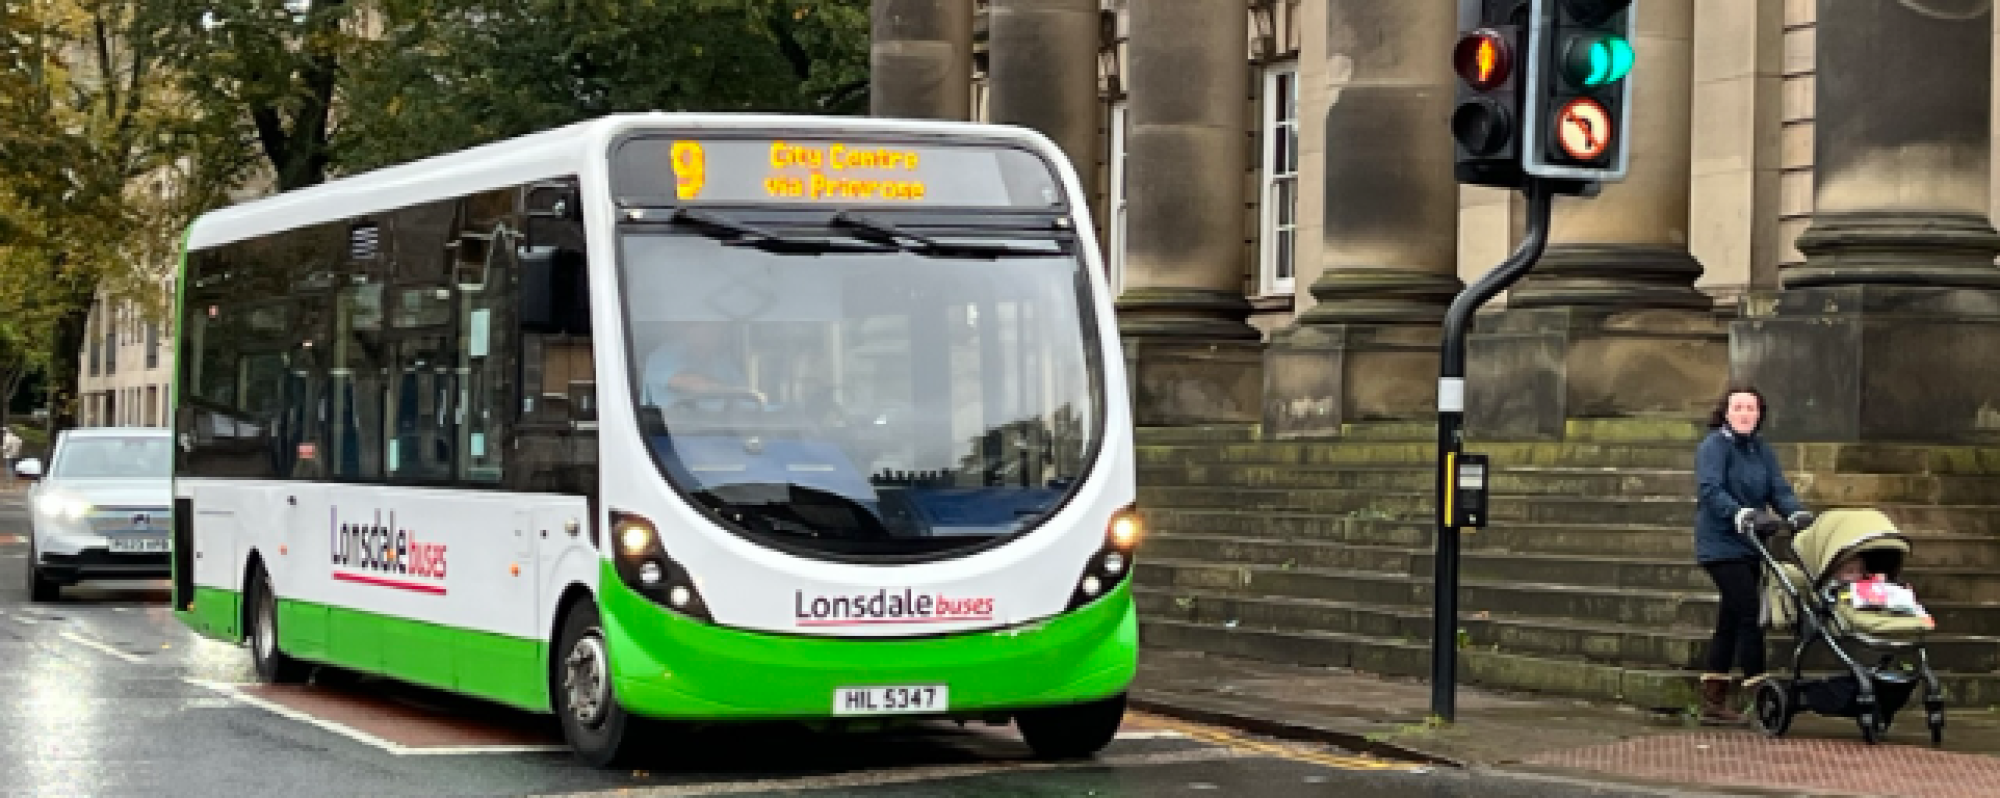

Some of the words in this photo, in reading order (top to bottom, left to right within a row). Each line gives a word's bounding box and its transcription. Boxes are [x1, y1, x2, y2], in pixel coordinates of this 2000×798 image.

[669, 139, 706, 200] 9
[769, 140, 824, 169] City
[829, 143, 919, 171] Centre
[763, 176, 804, 198] via
[809, 171, 926, 200] Primrose
[330, 504, 406, 574] Lonsdale
[408, 530, 447, 580] buses
[795, 586, 933, 619] Lonsdale
[935, 593, 994, 616] buses
[845, 687, 878, 709] HIL
[882, 687, 936, 709] 5347
